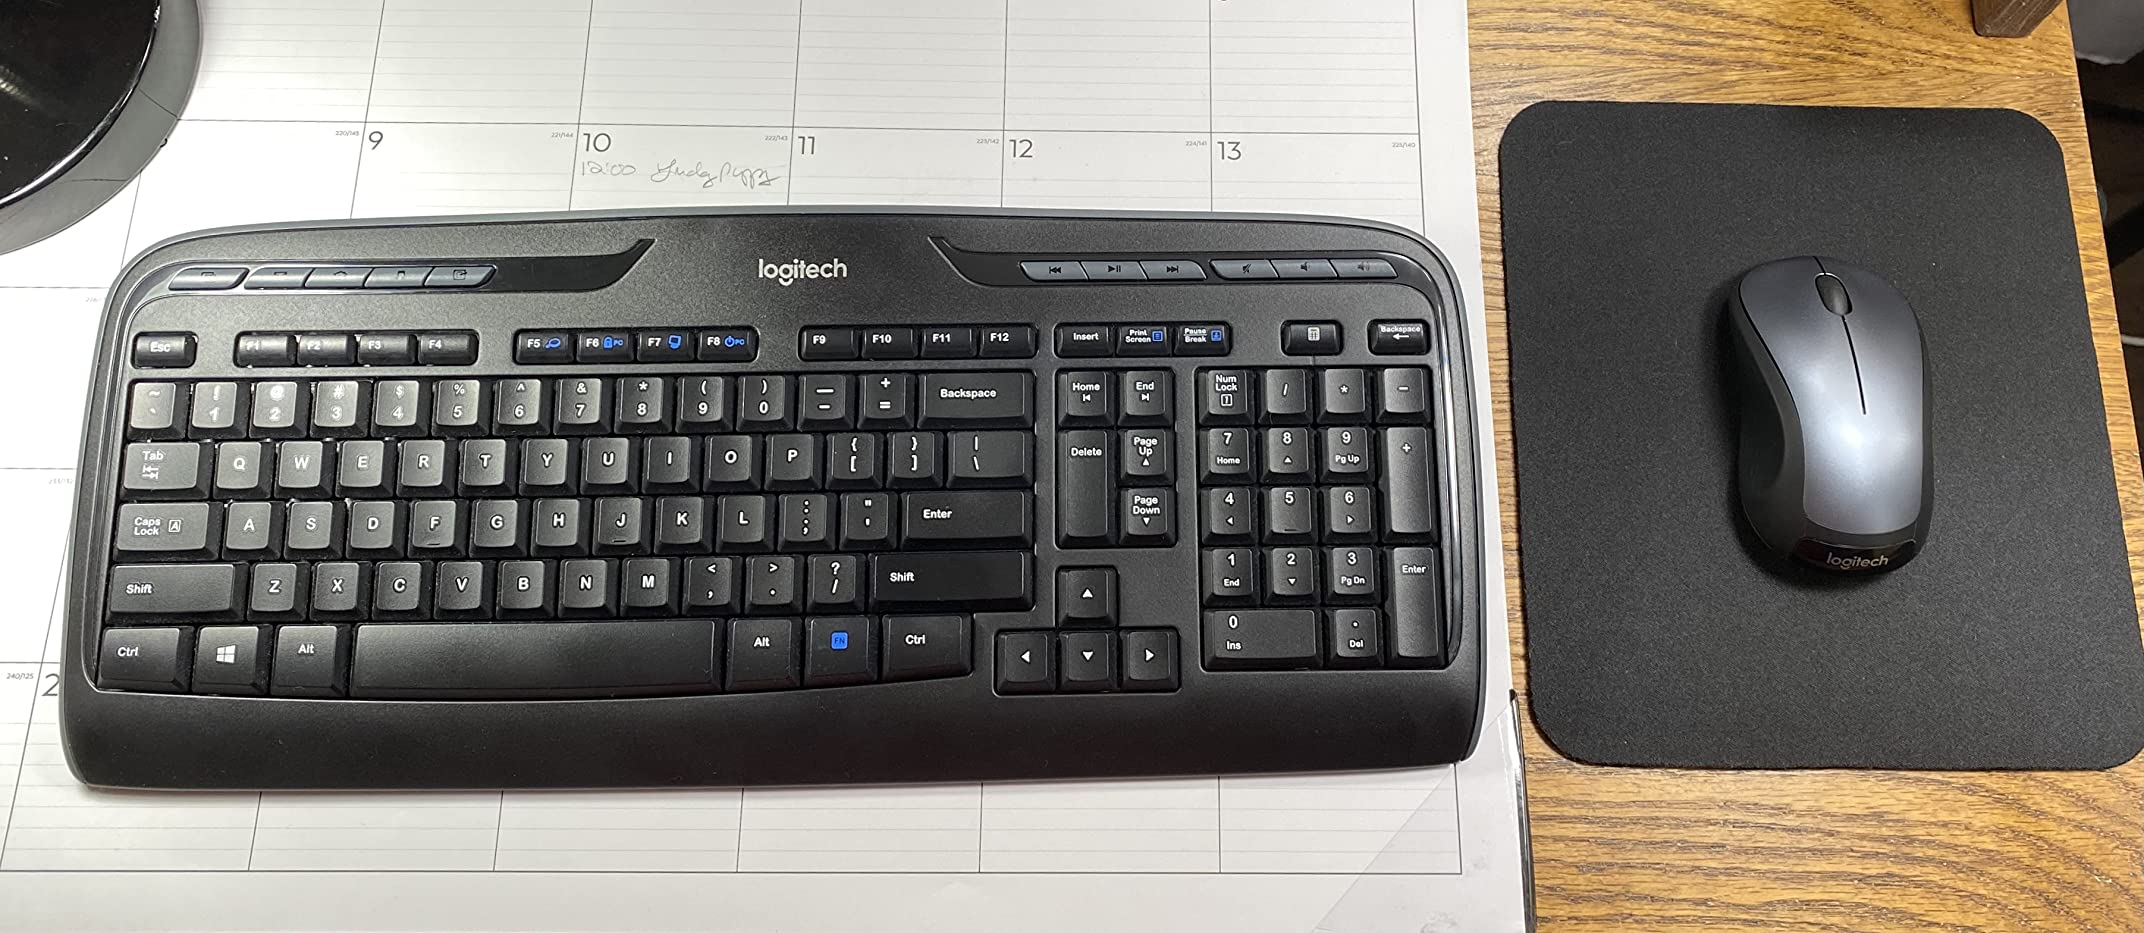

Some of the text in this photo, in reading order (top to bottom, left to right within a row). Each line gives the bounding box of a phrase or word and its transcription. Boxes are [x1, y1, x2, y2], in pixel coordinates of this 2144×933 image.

[368, 131, 384, 150] 9
[583, 133, 612, 152] 10
[798, 136, 816, 155] 11
[1009, 139, 1033, 158] 12
[1217, 141, 1242, 160] 13
[758, 258, 848, 286] logitech
[1380, 325, 1421, 334] Backspace
[527, 338, 541, 348] F5
[586, 338, 600, 348] F6
[647, 337, 662, 347] F7
[707, 336, 745, 346] F8 PC
[813, 335, 826, 345] F9
[872, 334, 892, 344] F10
[932, 333, 951, 343] F11
[990, 332, 1009, 342] F12
[1073, 332, 1099, 341] Insert
[1125, 335, 1152, 343] Screen
[1184, 335, 1207, 343] Break
[150, 341, 171, 352] Esc
[246, 341, 260, 350] F1
[307, 340, 321, 350] F2
[368, 340, 382, 350] F3
[428, 339, 442, 350] F4
[880, 377, 891, 389] +
[1215, 374, 1237, 383] Num
[333, 384, 345, 399] #
[394, 384, 405, 398] $
[453, 383, 465, 396] %
[576, 382, 588, 394] &
[700, 379, 708, 395] (
[760, 379, 768, 394] )
[1072, 382, 1100, 391] Home
[1135, 381, 1155, 391] End
[1215, 383, 1238, 392] Lock
[269, 385, 285, 402] @
[940, 388, 997, 400] Backspace
[393, 405, 405, 419] 4
[453, 405, 463, 418] 5
[514, 405, 524, 418] 6
[576, 404, 586, 417] 7
[637, 403, 648, 416] 8
[698, 402, 709, 415] 9
[759, 401, 769, 415] 0
[879, 401, 891, 410] =
[209, 407, 219, 421] 1
[269, 406, 281, 421] 2
[331, 406, 343, 420] 3
[911, 436, 918, 451] }
[1133, 436, 1158, 447] Page
[1223, 431, 1233, 445] 7
[1282, 431, 1292, 445] 8
[1341, 431, 1351, 444] 9
[851, 437, 858, 452] {
[1402, 443, 1411, 453] +
[142, 451, 165, 461] Tab
[724, 450, 738, 464] O
[787, 449, 798, 463] P
[1070, 447, 1102, 457] Delete
[1138, 446, 1153, 457] Up
[233, 457, 246, 471] Q
[294, 456, 310, 470] W
[358, 455, 369, 468] E
[418, 455, 430, 468] R
[480, 454, 492, 468] T
[542, 454, 553, 467] Y
[603, 453, 614, 466] U
[667, 452, 673, 465] I
[850, 455, 857, 472] [
[911, 454, 918, 471] ]
[1216, 456, 1241, 465] Home
[1335, 454, 1360, 465] Pg Up
[1133, 496, 1159, 507] Page
[1224, 492, 1235, 505] 4
[1285, 491, 1294, 504] 5
[1344, 491, 1354, 504] 6
[923, 509, 953, 519] Enter
[1132, 505, 1161, 515] Down
[134, 516, 161, 528] Caps
[305, 517, 317, 530] S
[367, 517, 379, 530] D
[429, 516, 440, 530] F
[490, 515, 504, 529] G
[553, 514, 565, 527] H
[615, 513, 626, 527] J
[676, 512, 688, 526] K
[739, 511, 749, 524] L
[134, 525, 160, 536] Lock
[243, 518, 256, 531] A
[1227, 553, 1235, 566] 1
[1286, 553, 1296, 566] 2
[1347, 552, 1357, 565] 3
[1825, 552, 1889, 570] logitech
[707, 563, 717, 574] <
[769, 562, 779, 573] >
[831, 561, 841, 575] ?
[1402, 565, 1427, 574] Enter
[518, 577, 530, 590] B
[580, 576, 592, 590] N
[641, 575, 655, 589] M
[889, 571, 915, 583] Shift
[1223, 578, 1240, 587] End
[1341, 576, 1365, 586] Pg Dn
[126, 583, 153, 594] Shift
[268, 580, 281, 593] Z
[331, 579, 343, 592] X
[393, 578, 407, 592] C
[456, 578, 468, 592] V
[1228, 616, 1238, 629] 0
[753, 636, 770, 647] Alt
[834, 636, 845, 645] FN
[905, 634, 926, 645] Ctrl
[1226, 641, 1242, 650] Ins
[1349, 639, 1364, 648] Del
[117, 646, 139, 657] Ctrl
[297, 643, 315, 654] Alt
[6, 672, 34, 680] 240/125
